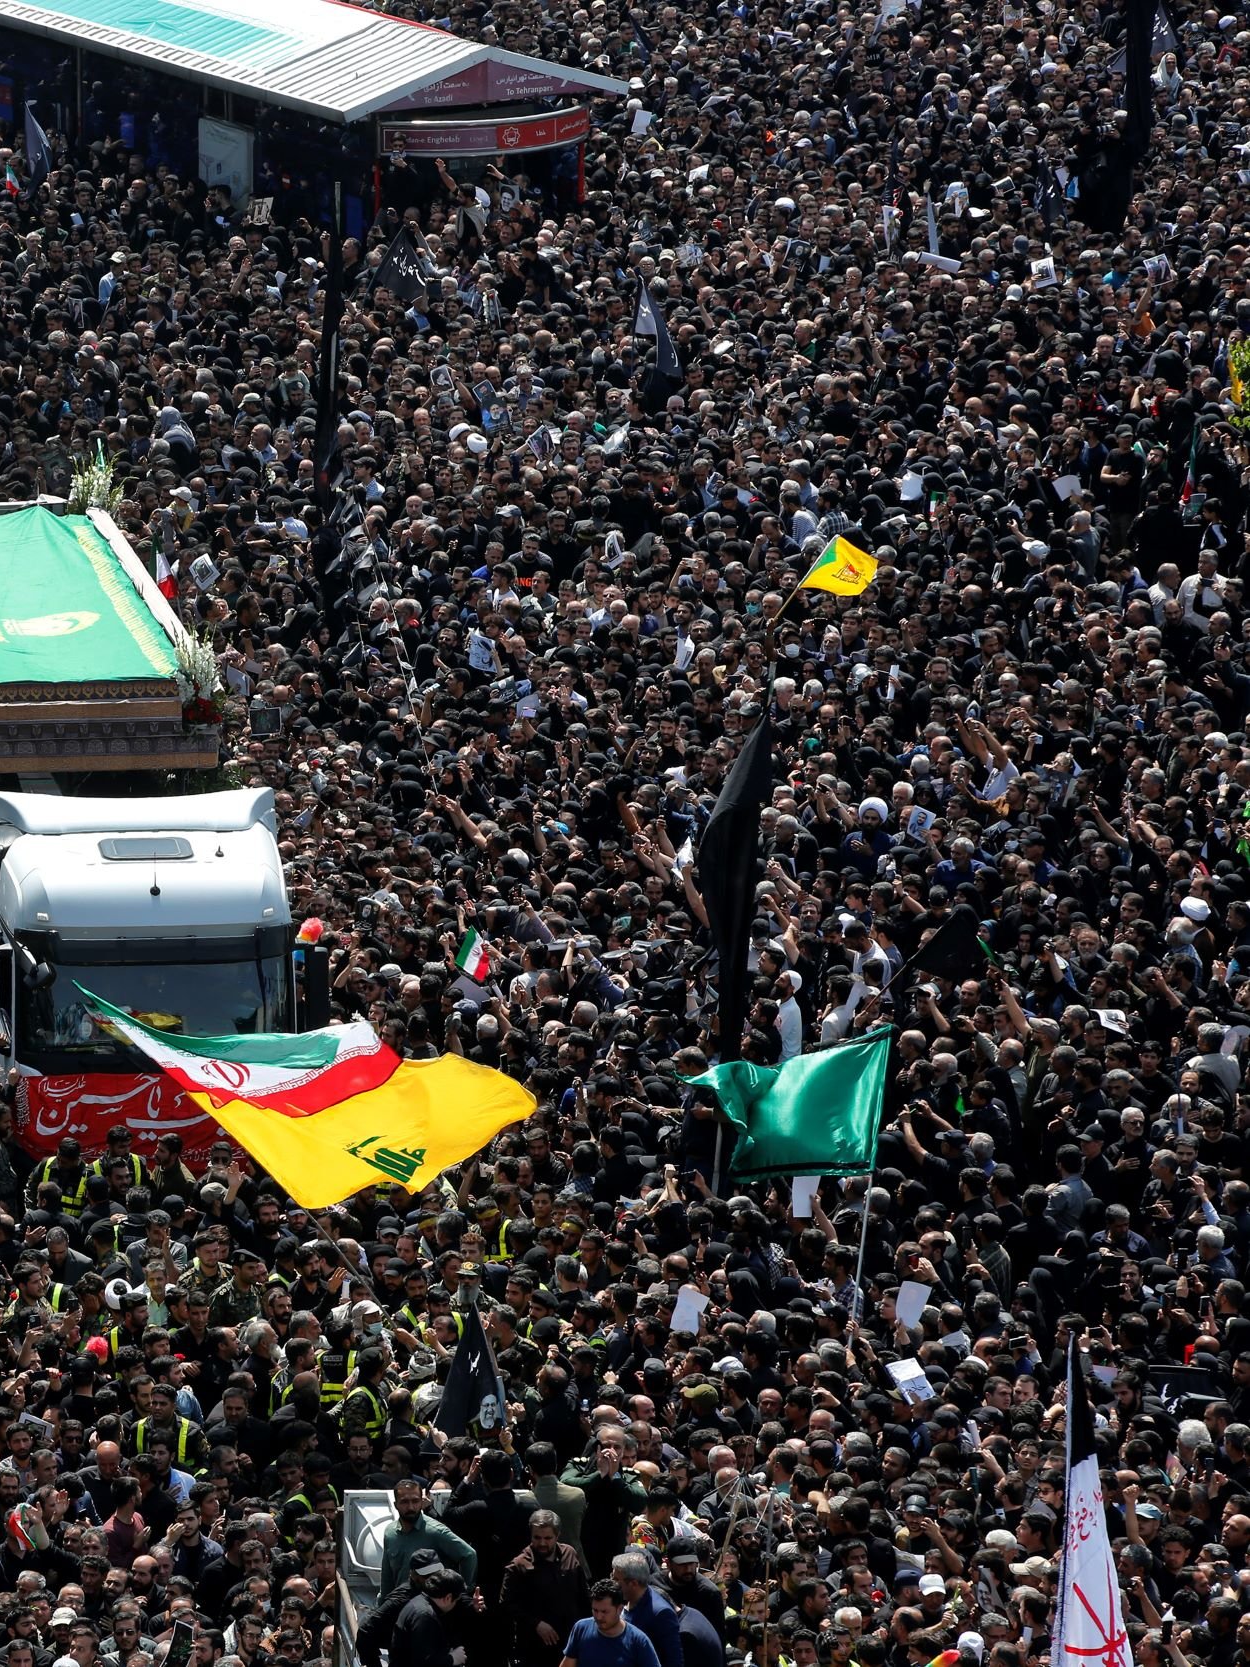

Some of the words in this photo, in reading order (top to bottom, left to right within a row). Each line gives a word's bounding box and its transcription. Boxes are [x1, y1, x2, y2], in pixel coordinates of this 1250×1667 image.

[506, 88, 515, 96] To
[516, 85, 554, 95] Tehranpars
[423, 96, 431, 104] To
[433, 94, 453, 103] Azadi
[427, 135, 460, 145] Enghelab
[35, 1072, 161, 1137] حسین
